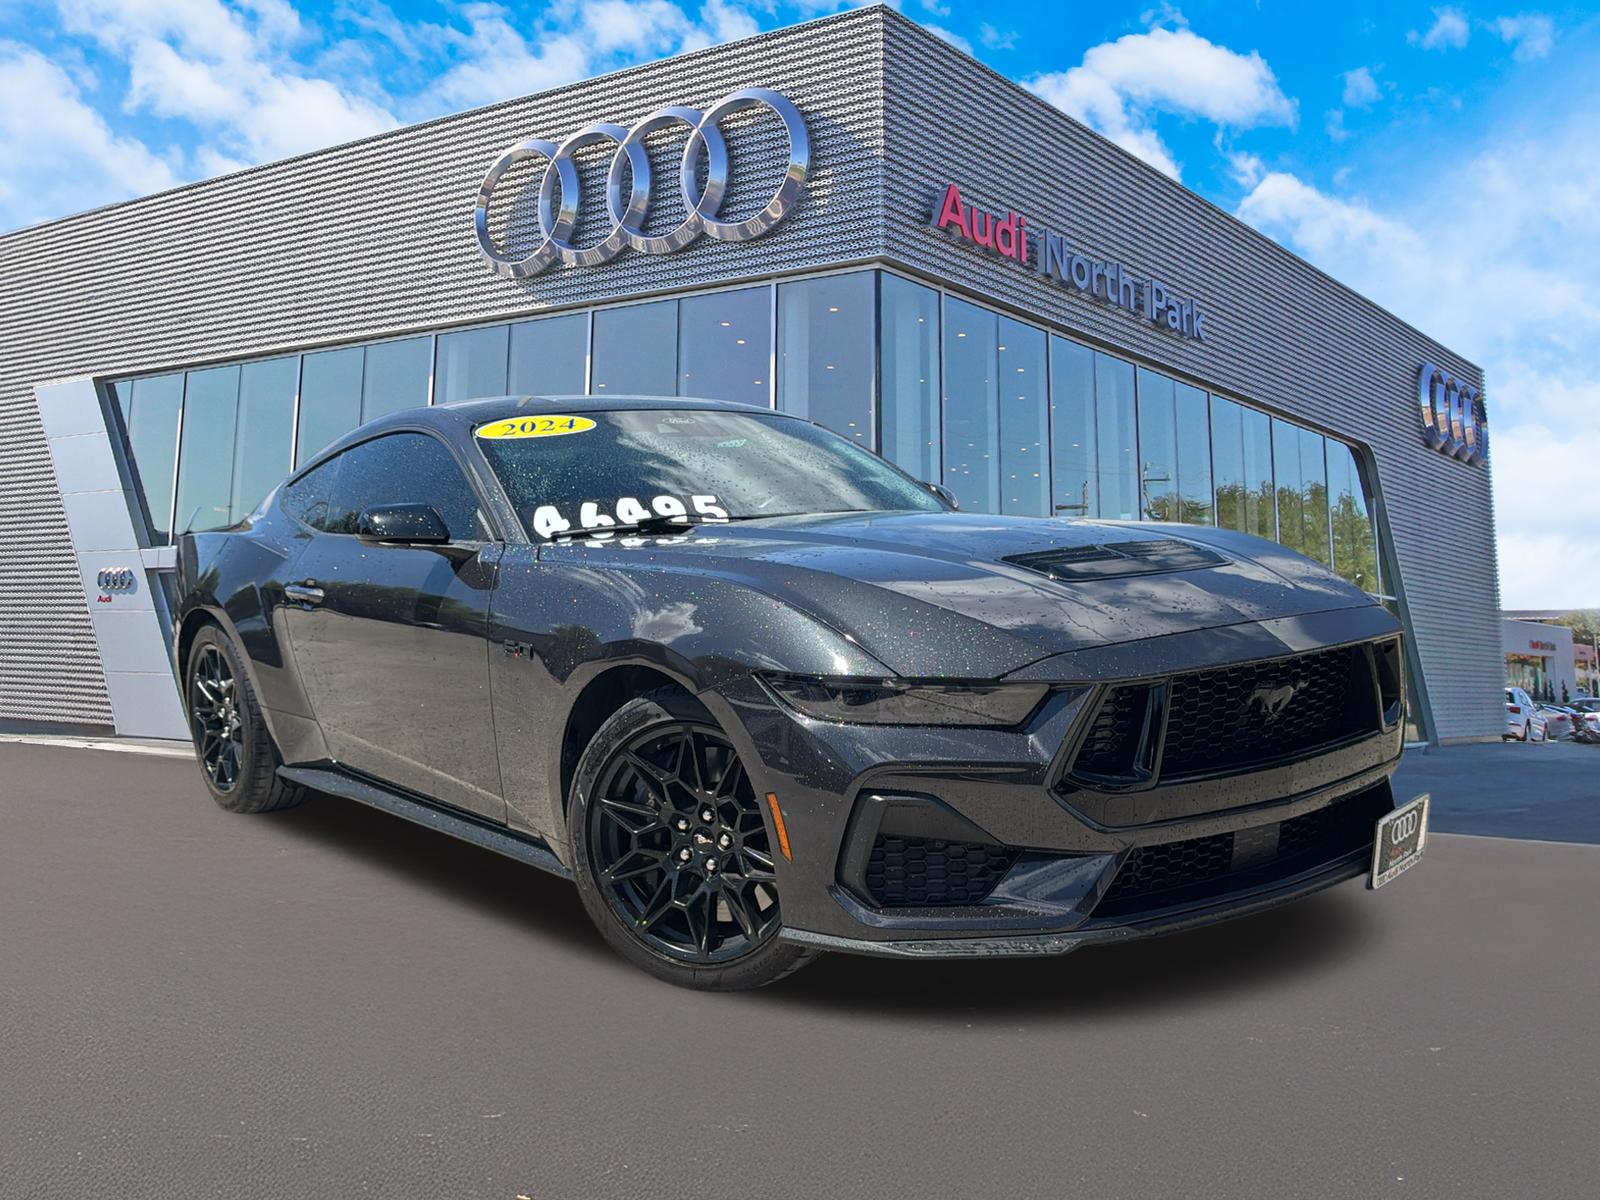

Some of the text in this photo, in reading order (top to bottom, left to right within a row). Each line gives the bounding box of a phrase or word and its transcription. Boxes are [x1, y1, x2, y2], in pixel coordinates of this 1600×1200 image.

[934, 183, 1206, 341] Audi North Park
[500, 418, 577, 437] 2024
[533, 495, 729, 542] 46495
